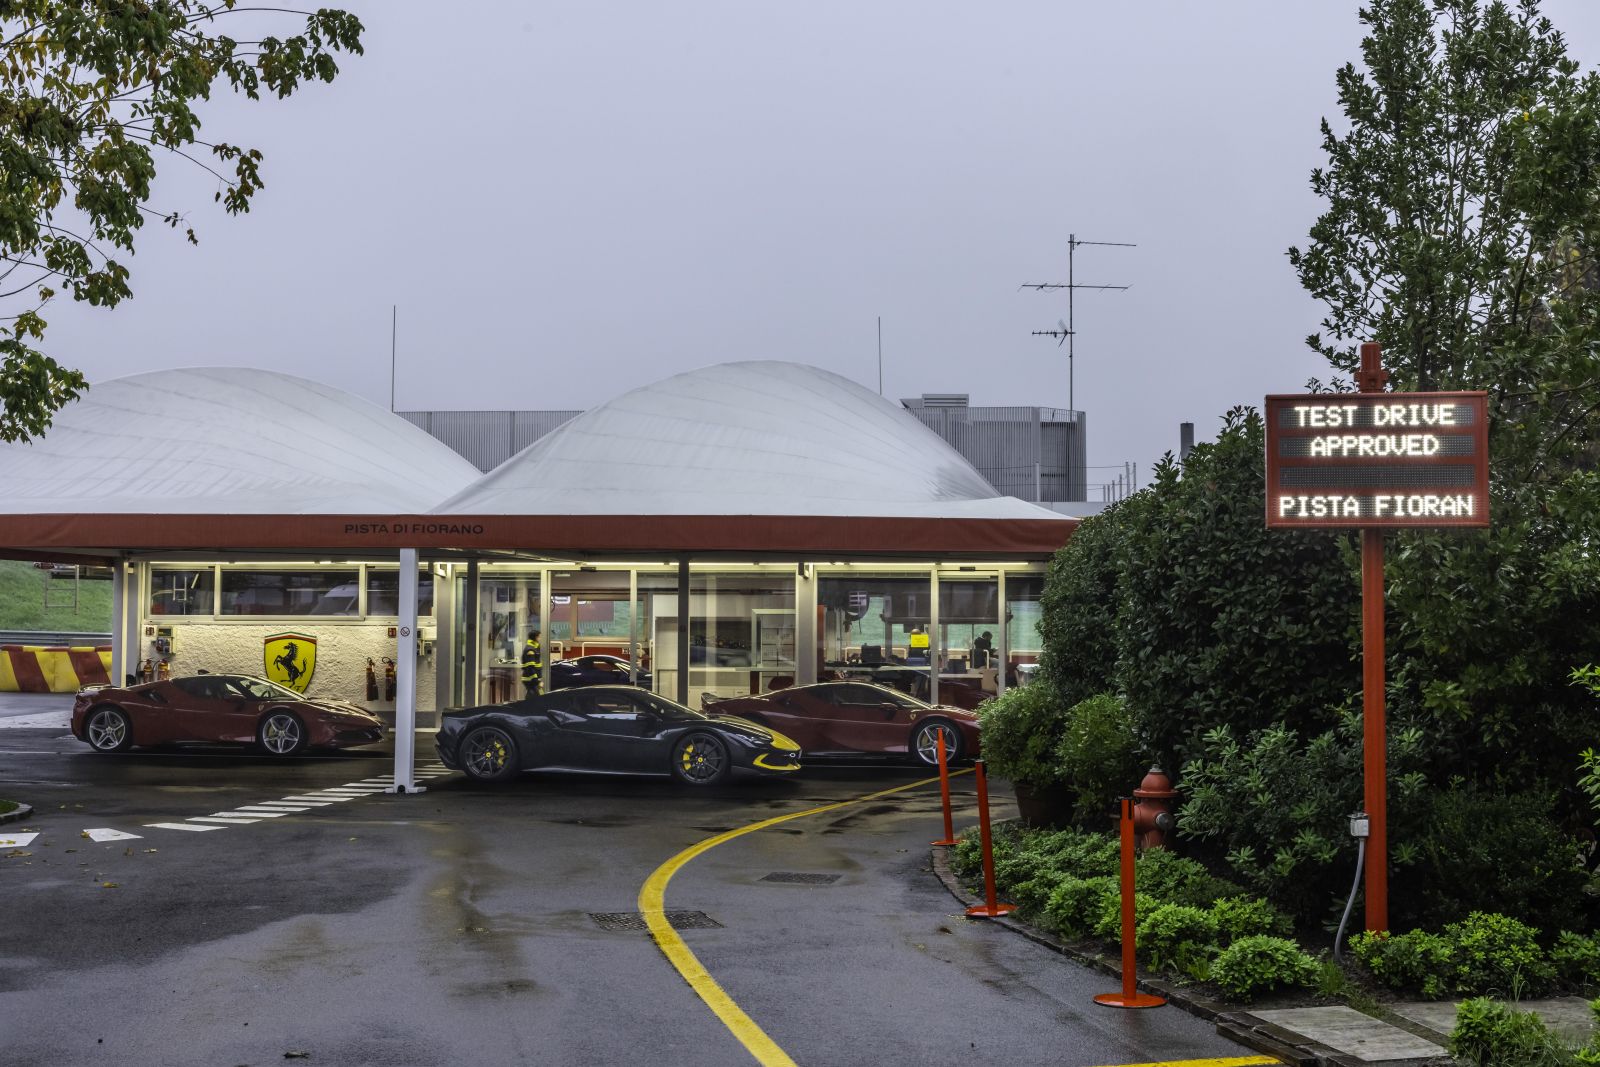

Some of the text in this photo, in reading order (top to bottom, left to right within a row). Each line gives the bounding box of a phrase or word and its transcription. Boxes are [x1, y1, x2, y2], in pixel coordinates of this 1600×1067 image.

[1295, 404, 1456, 427] TEST DRIVE
[1310, 434, 1440, 456] APPROVED
[1279, 495, 1474, 517] PISTA FIORAN
[344, 524, 484, 535] PISTA DI FIORANO
